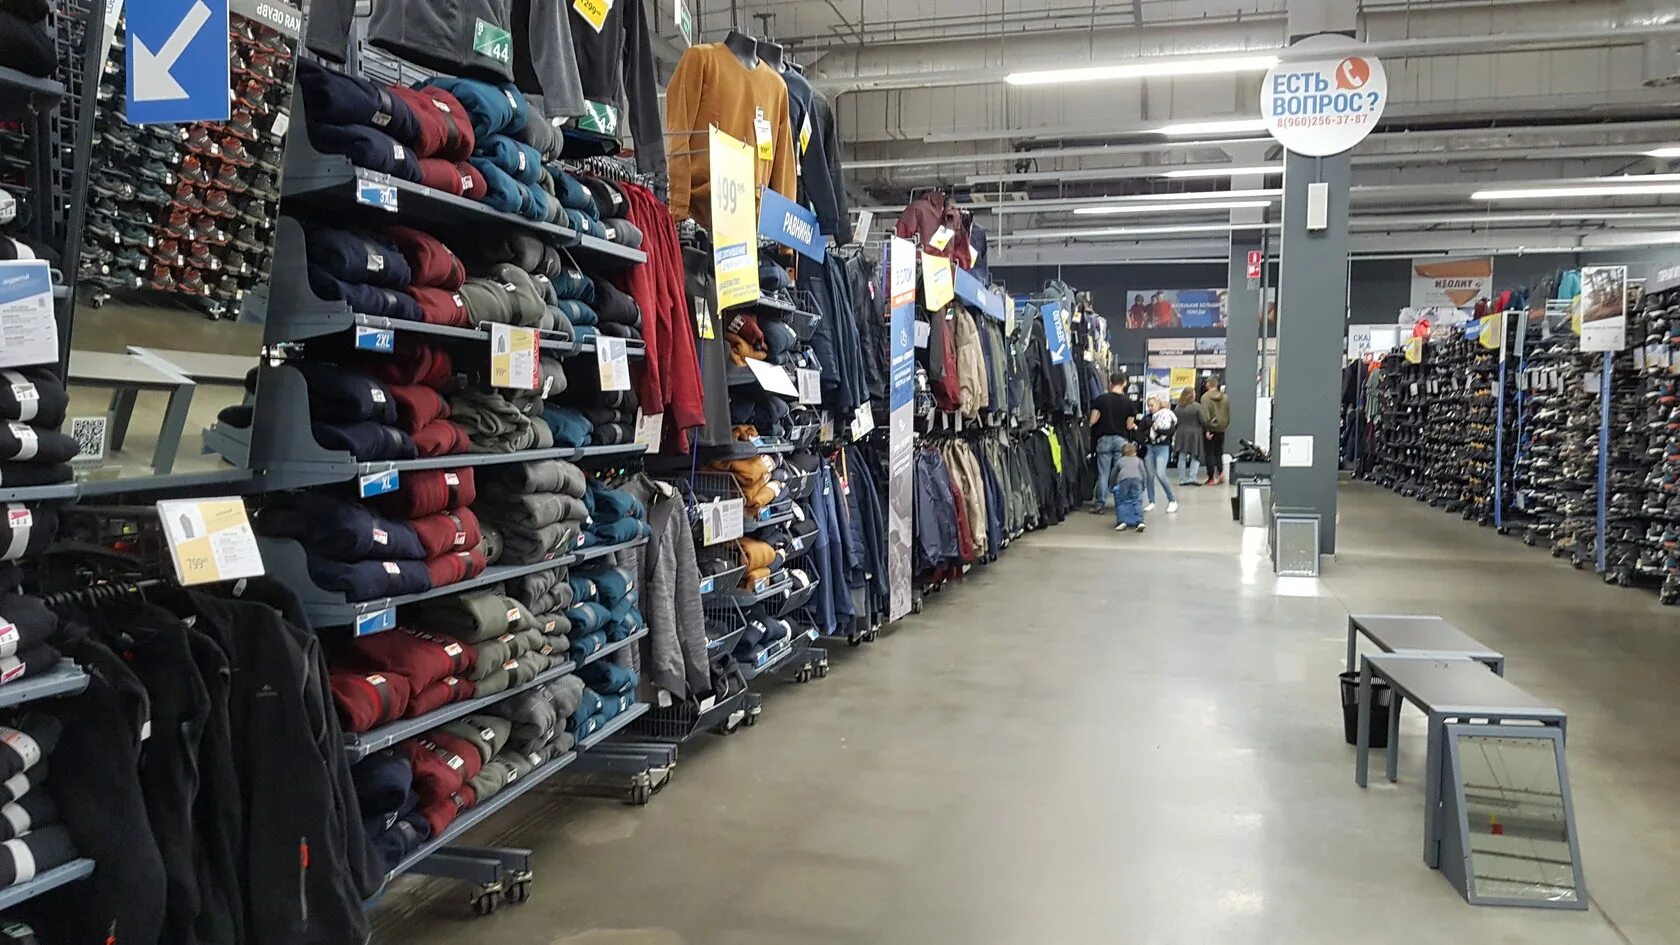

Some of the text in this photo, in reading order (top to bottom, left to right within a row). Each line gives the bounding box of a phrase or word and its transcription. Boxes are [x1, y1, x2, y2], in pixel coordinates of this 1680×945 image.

[493, 43, 509, 63] 44
[1272, 71, 1329, 95] ЕСТЬ
[1272, 91, 1380, 116] ВОПРОС?
[1277, 113, 1368, 129] 8(960)256-37-87
[379, 189, 396, 205] 3XL
[782, 211, 813, 246] РАВНИНЫ
[375, 333, 391, 348] 2XL
[381, 475, 393, 491] XL
[382, 613, 389, 627] L
